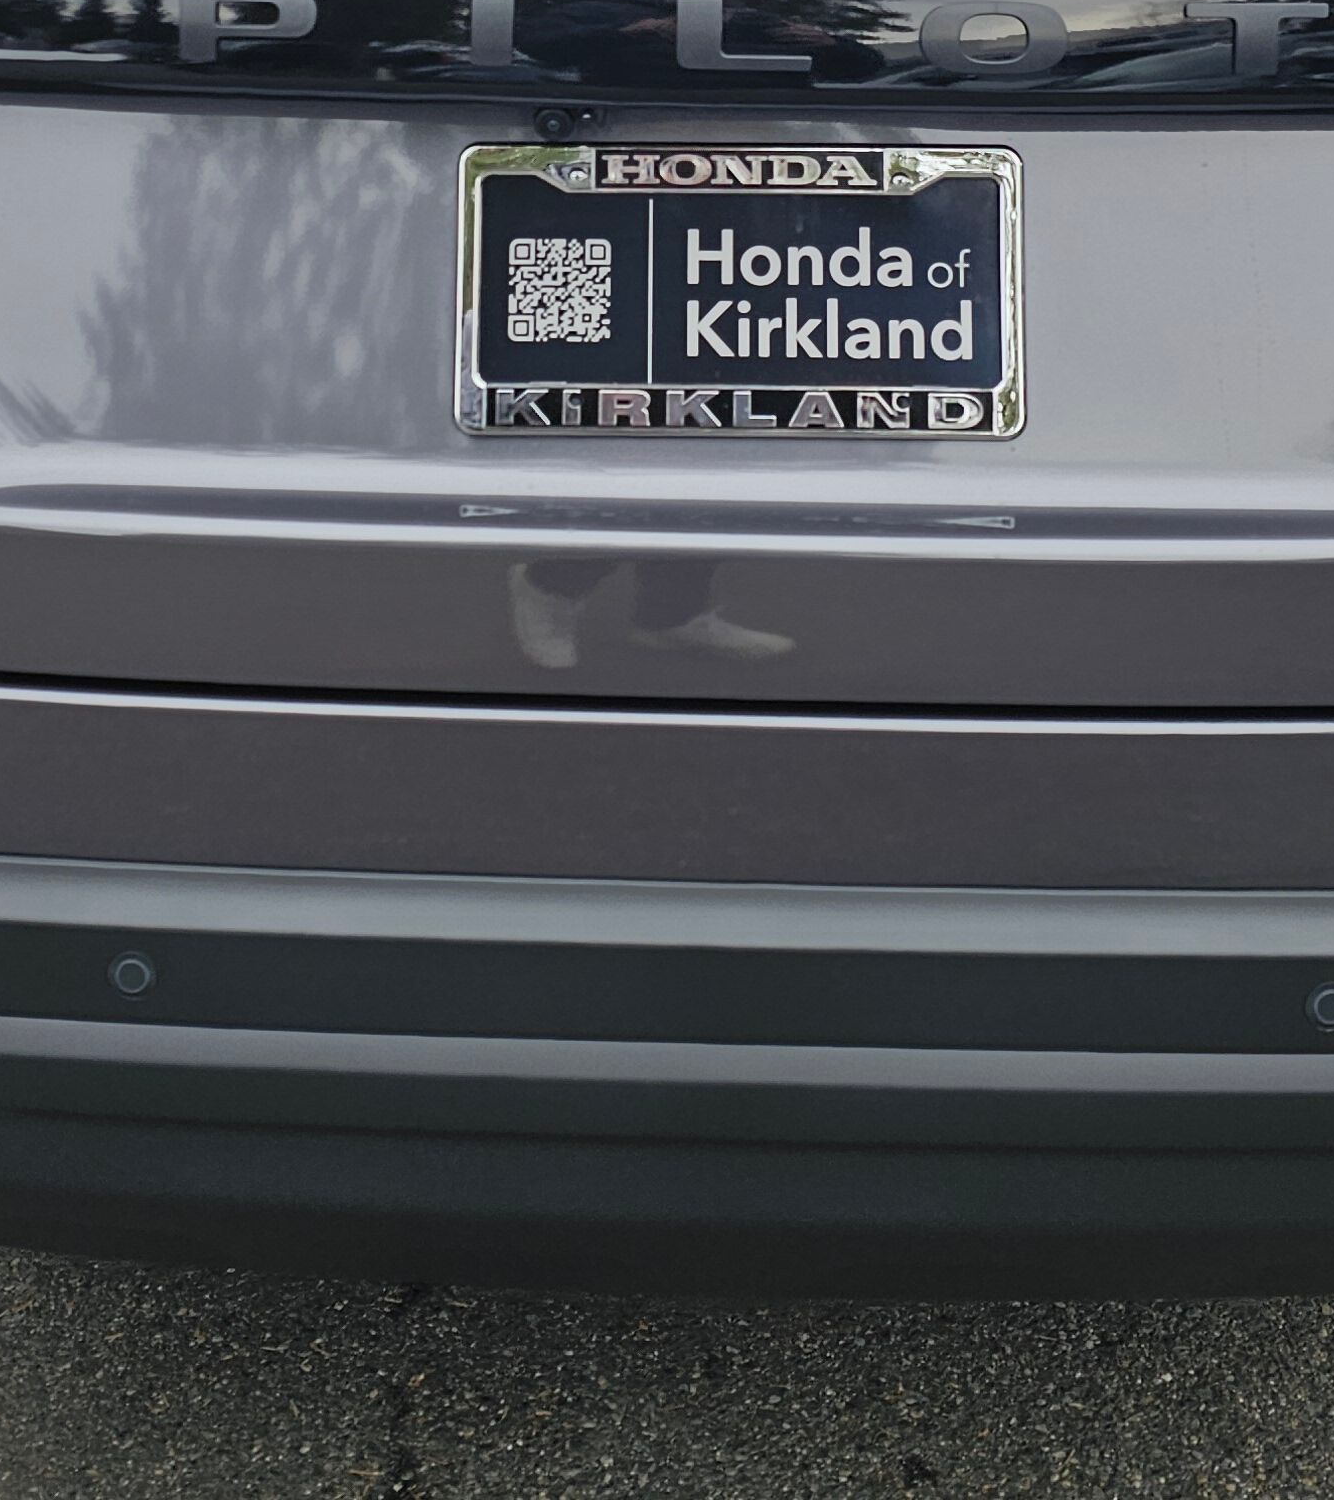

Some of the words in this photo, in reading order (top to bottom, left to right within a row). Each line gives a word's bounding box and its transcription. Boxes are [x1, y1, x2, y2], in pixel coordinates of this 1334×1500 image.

[600, 153, 878, 188] HONDA
[685, 226, 914, 287] Honda
[926, 248, 971, 289] of
[685, 297, 974, 361] Kirkland
[494, 388, 985, 430] KIRKLAND
